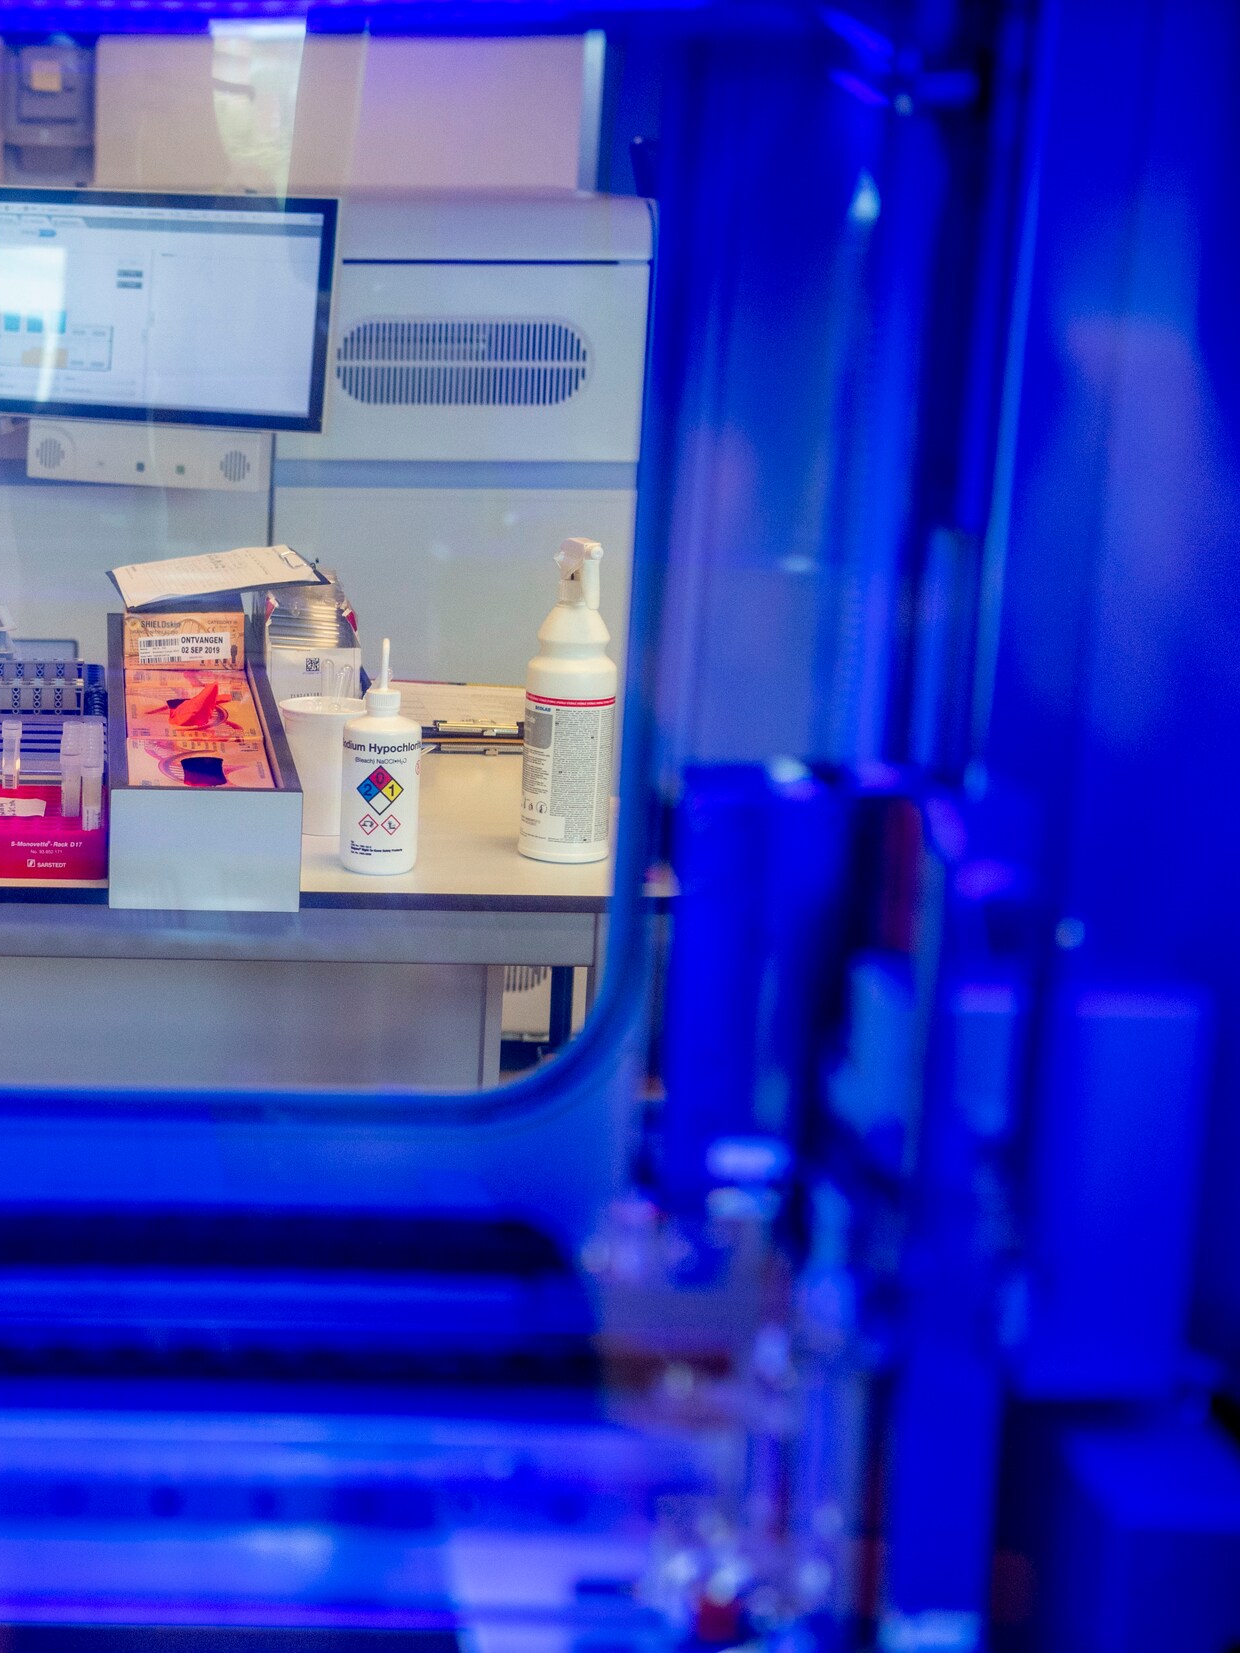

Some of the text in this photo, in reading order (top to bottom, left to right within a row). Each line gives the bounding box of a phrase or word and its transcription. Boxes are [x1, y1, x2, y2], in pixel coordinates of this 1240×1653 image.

[181, 636, 224, 644] ONTVANGEN
[181, 646, 189, 654] 02
[190, 646, 203, 654] SEP
[204, 646, 220, 654] 2019
[375, 771, 385, 785] 0
[363, 783, 395, 797] 2 1
